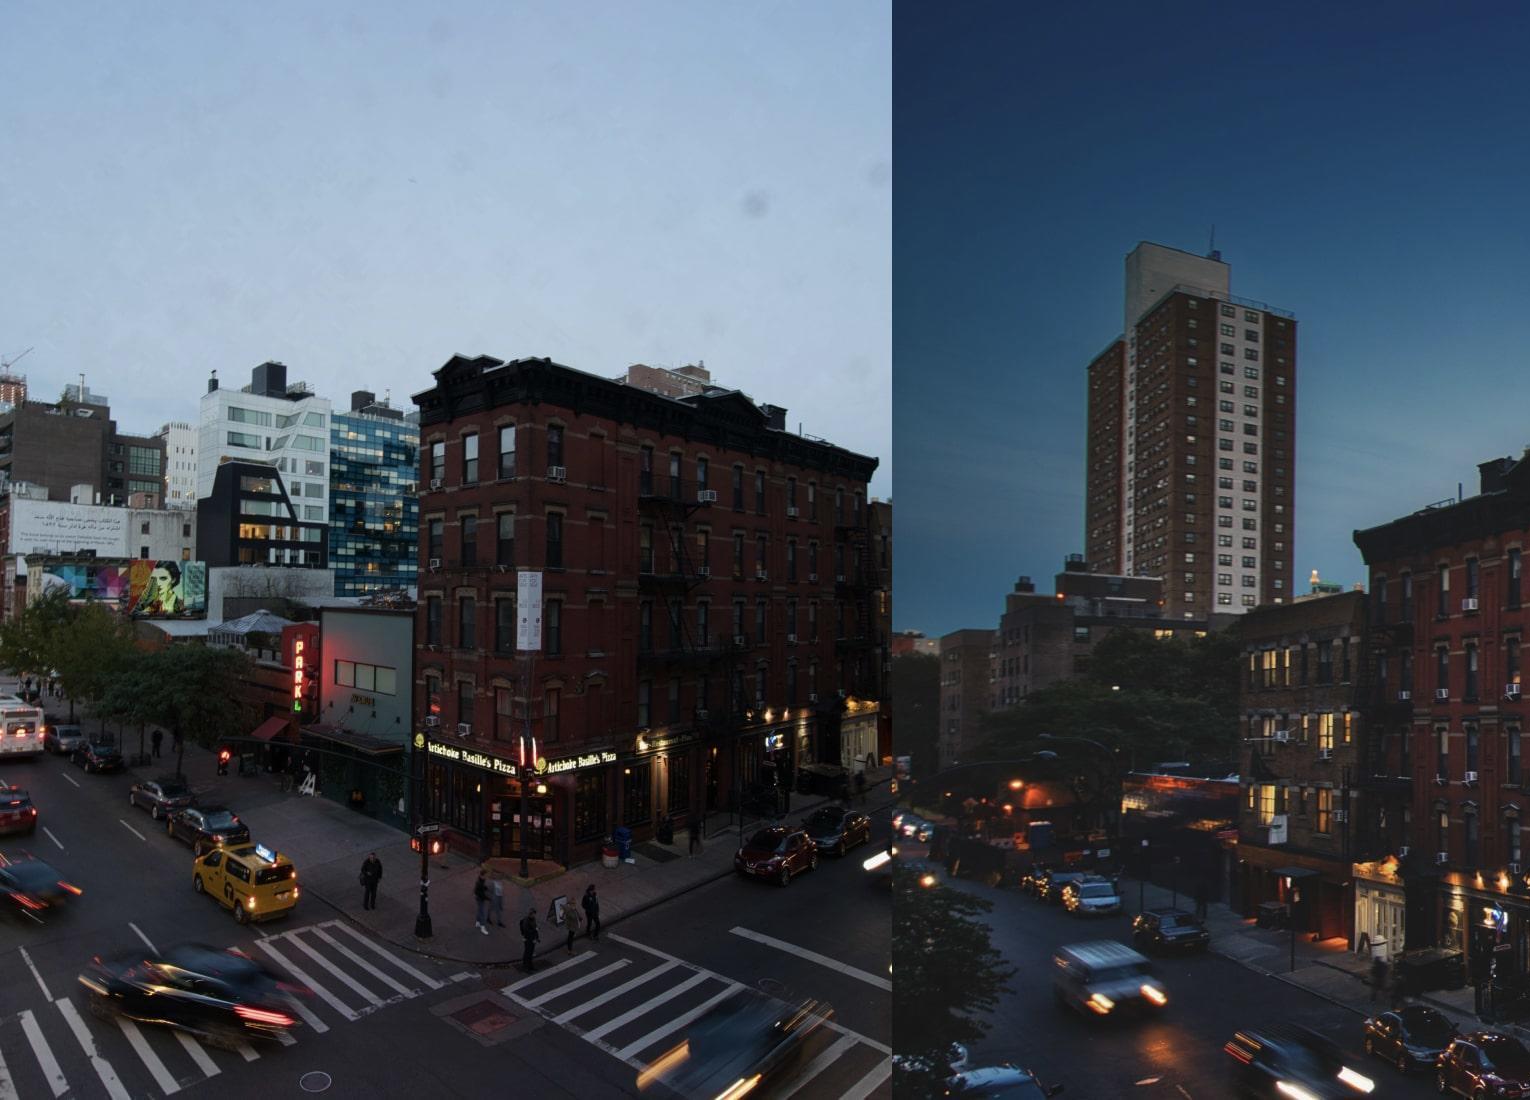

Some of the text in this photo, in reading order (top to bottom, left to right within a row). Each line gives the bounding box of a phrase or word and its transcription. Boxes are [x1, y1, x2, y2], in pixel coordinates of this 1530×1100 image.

[294, 640, 304, 699] PARK
[428, 741, 516, 775] Artichoke Basille's Pizza
[547, 759, 577, 774] Artichoke
[601, 751, 617, 763] Pizza
